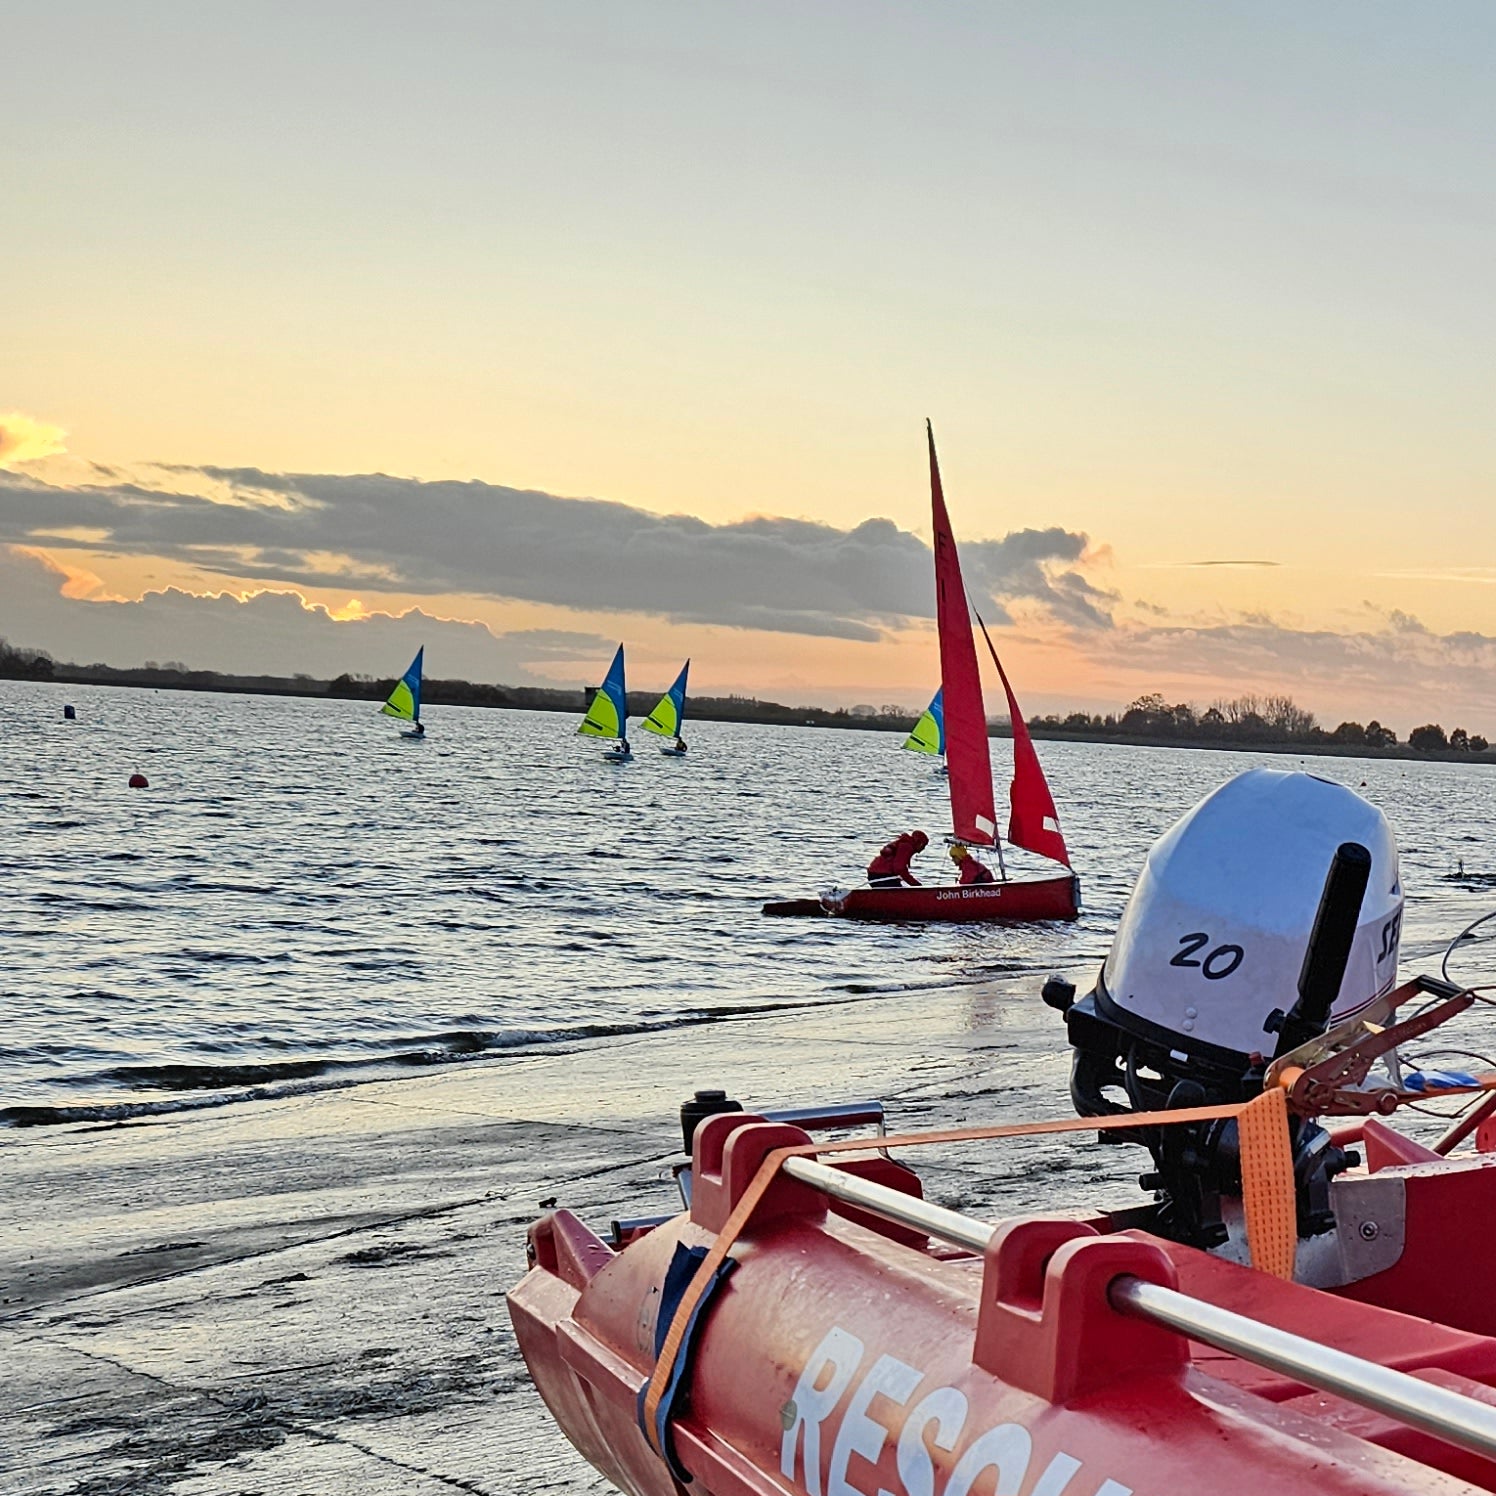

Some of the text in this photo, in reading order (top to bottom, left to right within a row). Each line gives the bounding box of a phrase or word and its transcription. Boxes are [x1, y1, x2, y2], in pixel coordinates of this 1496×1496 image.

[936, 888, 1001, 900] John Birkhead
[1169, 932, 1244, 980] 20
